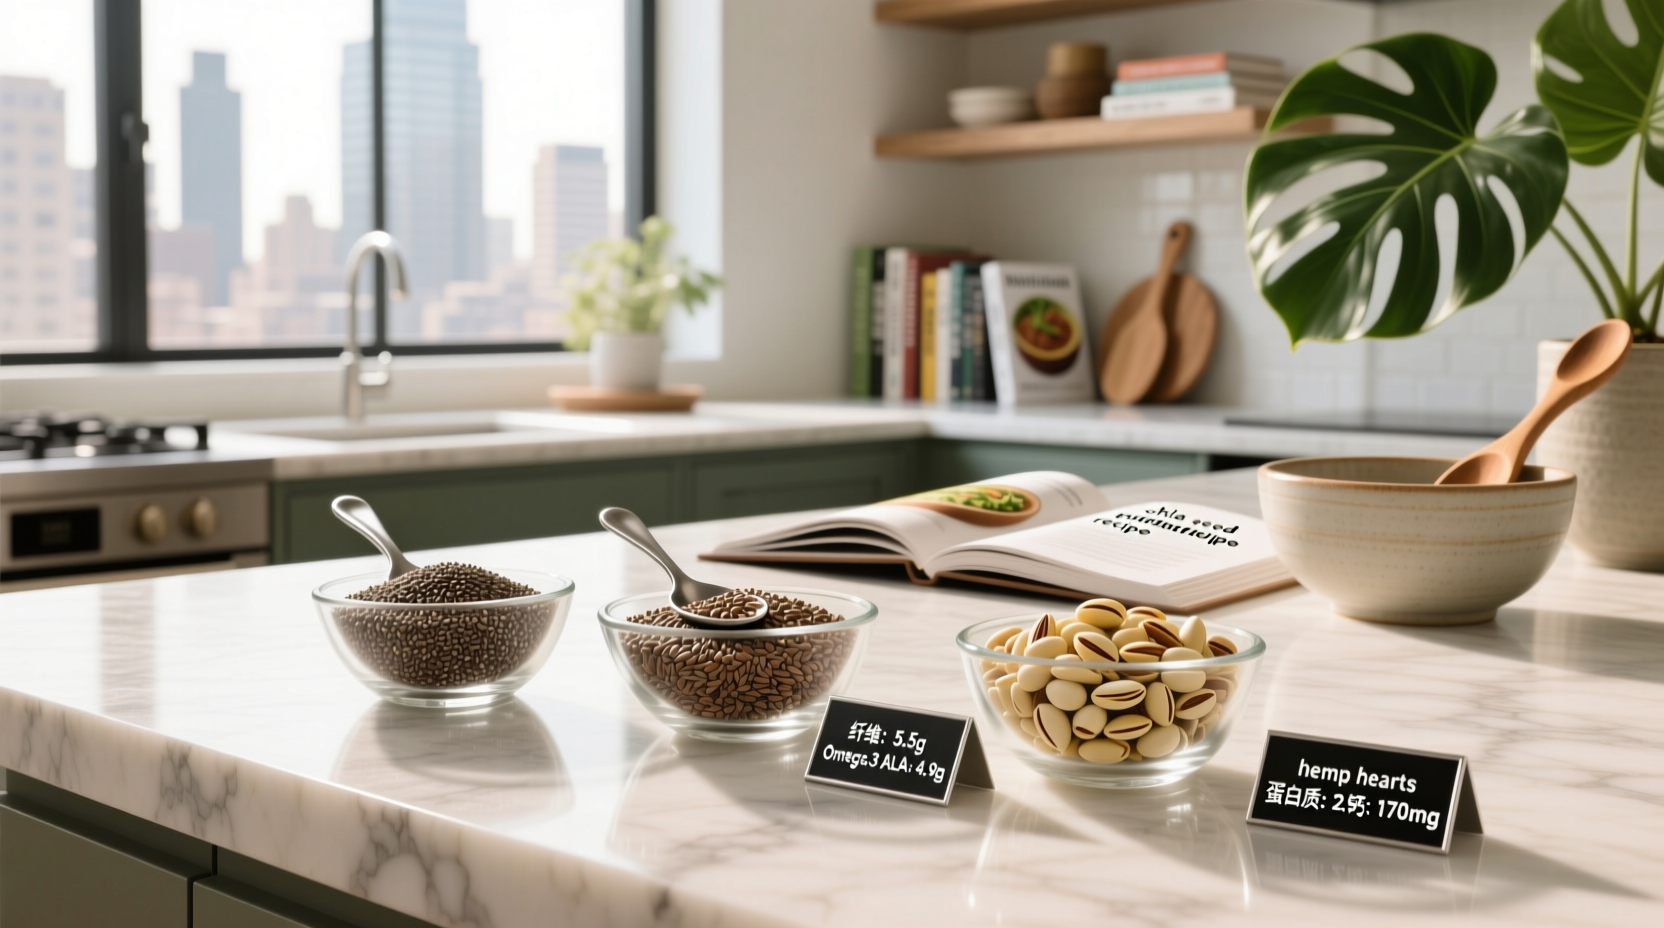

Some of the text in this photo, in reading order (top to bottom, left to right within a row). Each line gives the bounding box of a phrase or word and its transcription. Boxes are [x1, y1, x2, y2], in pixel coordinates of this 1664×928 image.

[893, 730, 927, 755] 5.5g
[915, 760, 945, 783] 4.9g
[1298, 758, 1417, 793] hemp hearts
[1378, 799, 1440, 831] 170mg
